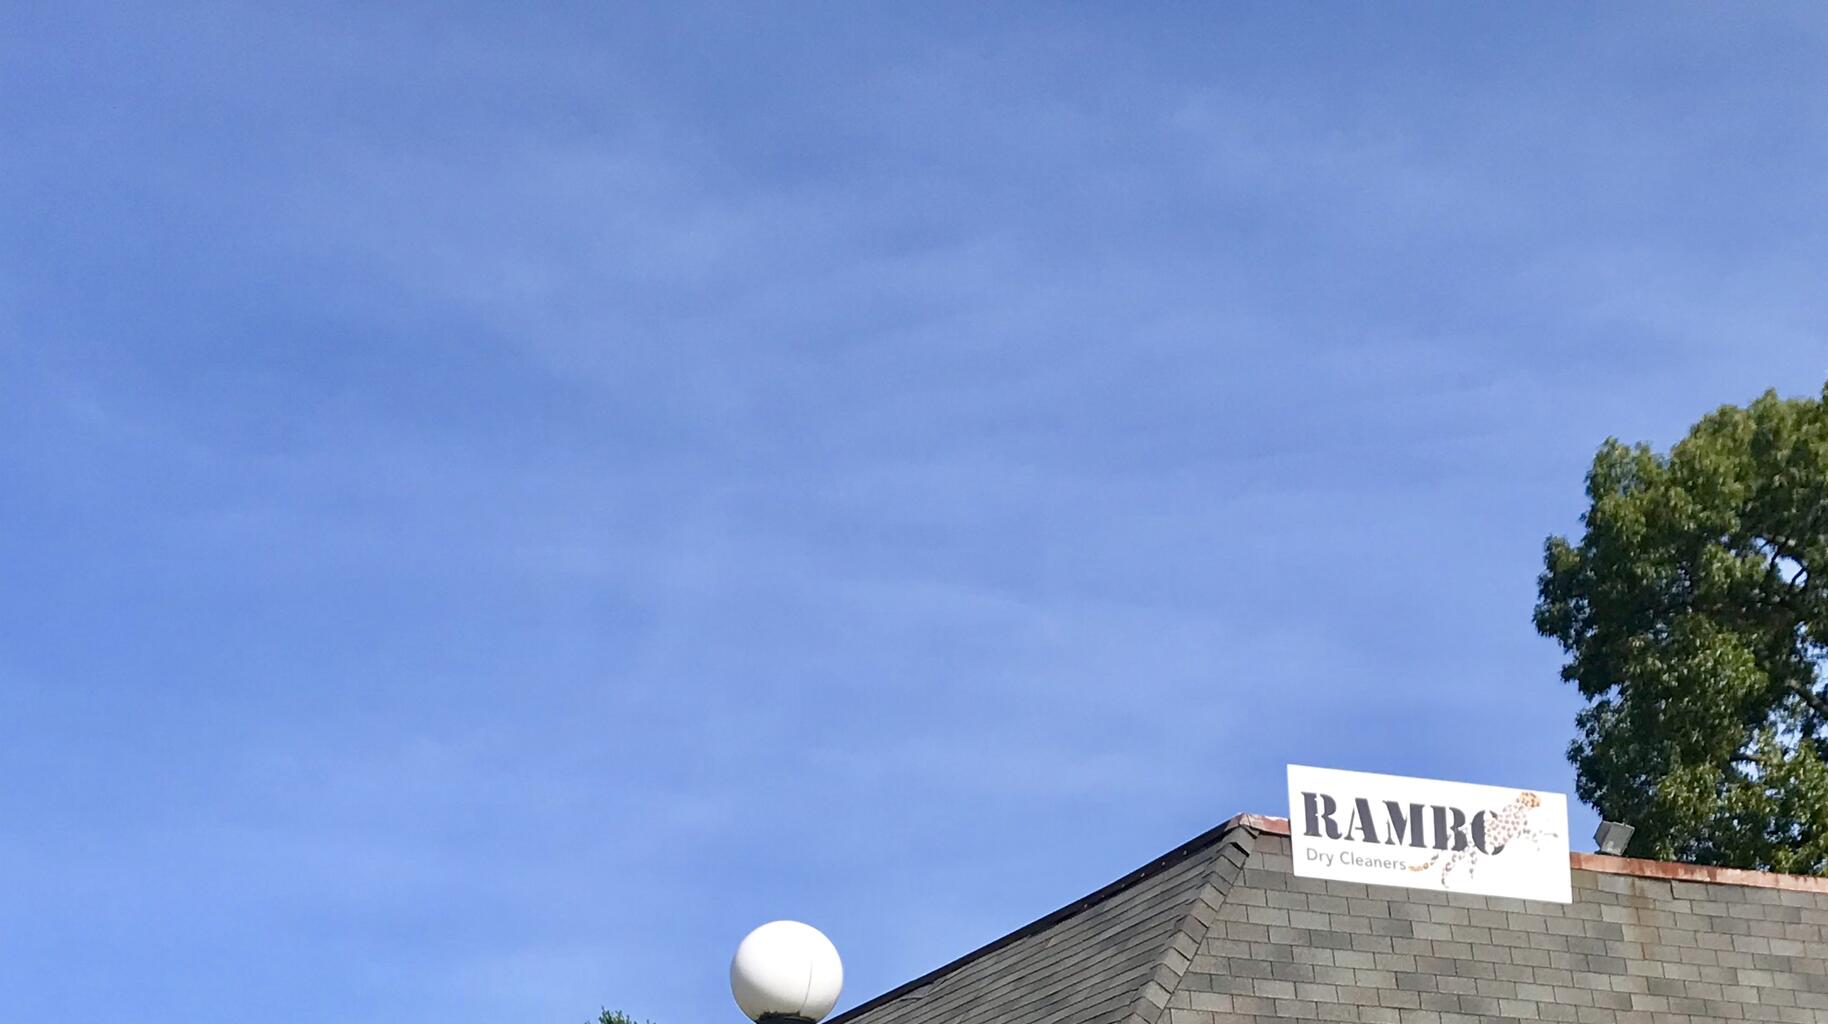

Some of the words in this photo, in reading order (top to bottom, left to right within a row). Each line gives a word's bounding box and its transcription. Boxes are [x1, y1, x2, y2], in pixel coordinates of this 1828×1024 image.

[1301, 791, 1505, 856] RAMBO
[1306, 847, 1333, 867] Dry
[1340, 851, 1407, 871] Cleaners
